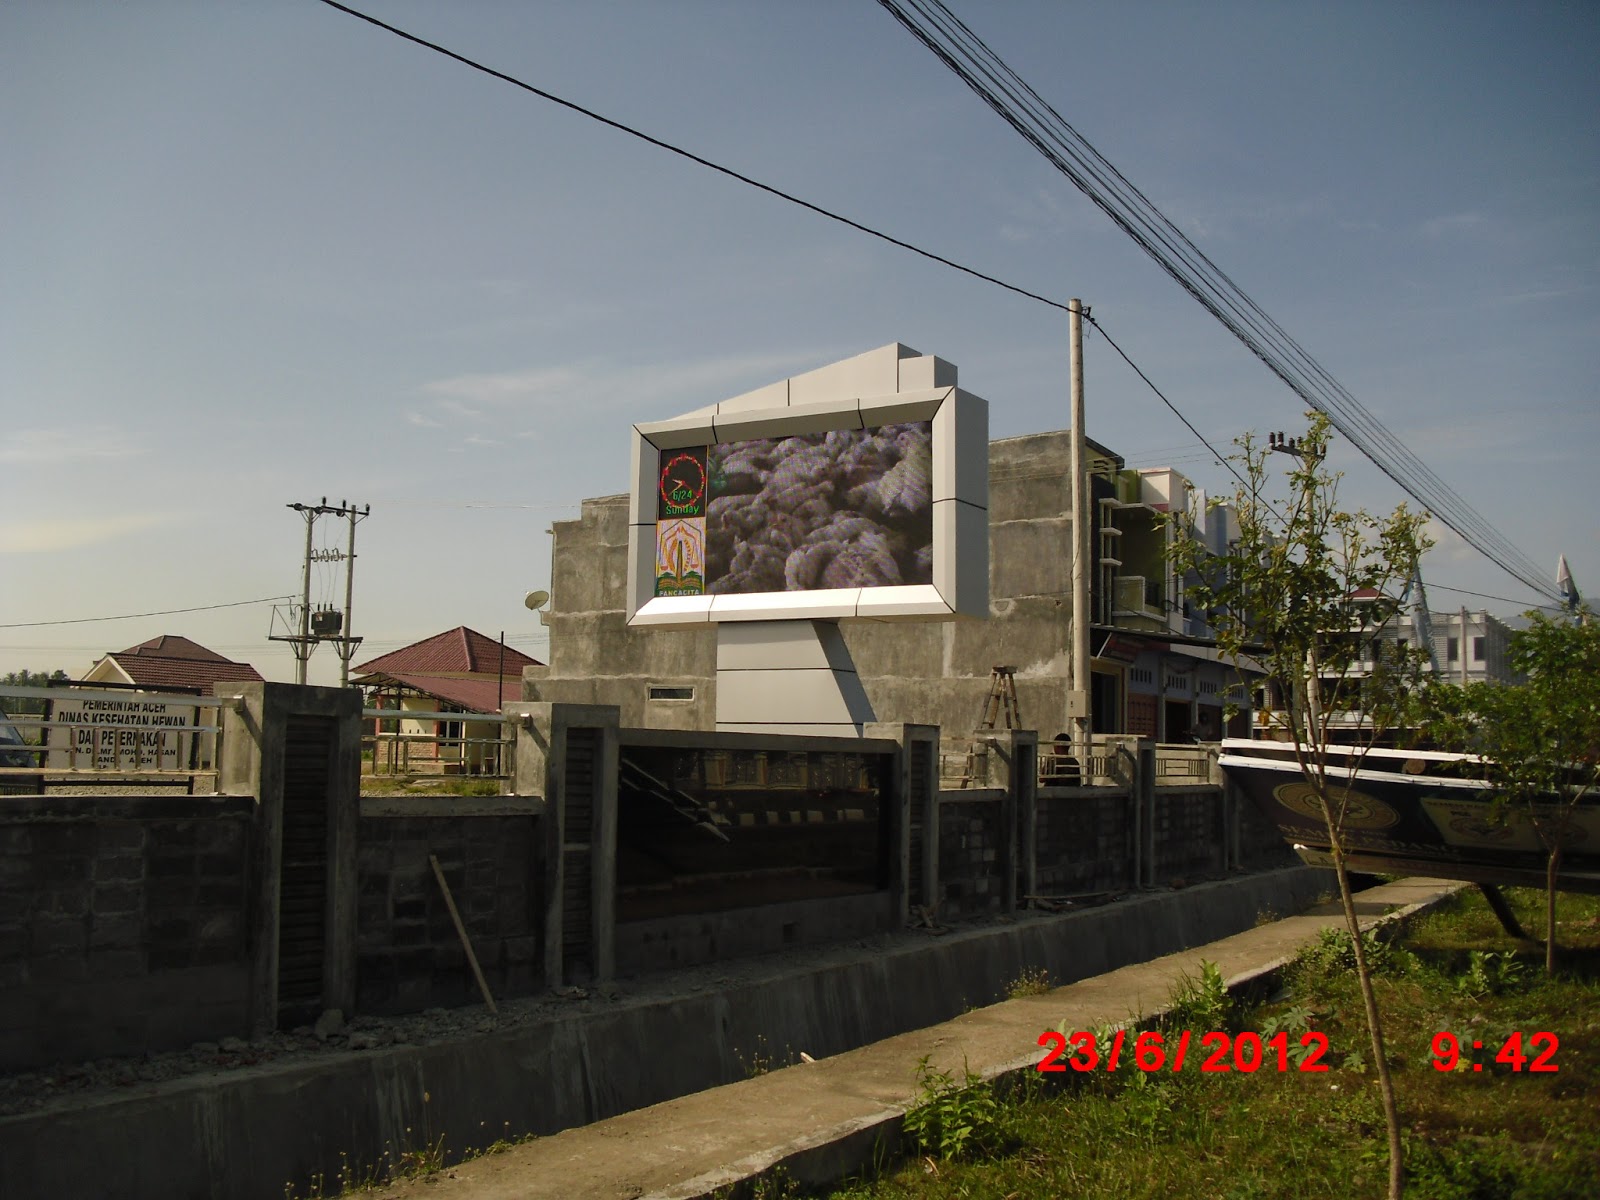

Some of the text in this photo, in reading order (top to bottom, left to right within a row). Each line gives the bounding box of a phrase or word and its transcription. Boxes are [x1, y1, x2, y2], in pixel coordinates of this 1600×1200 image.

[673, 490, 692, 503] 6/24
[666, 504, 699, 515] Sunday
[83, 700, 166, 713] PEMERINTAH ACEH
[59, 711, 185, 726] DINAS KESEHATAN HEWAN
[79, 729, 98, 744] DA
